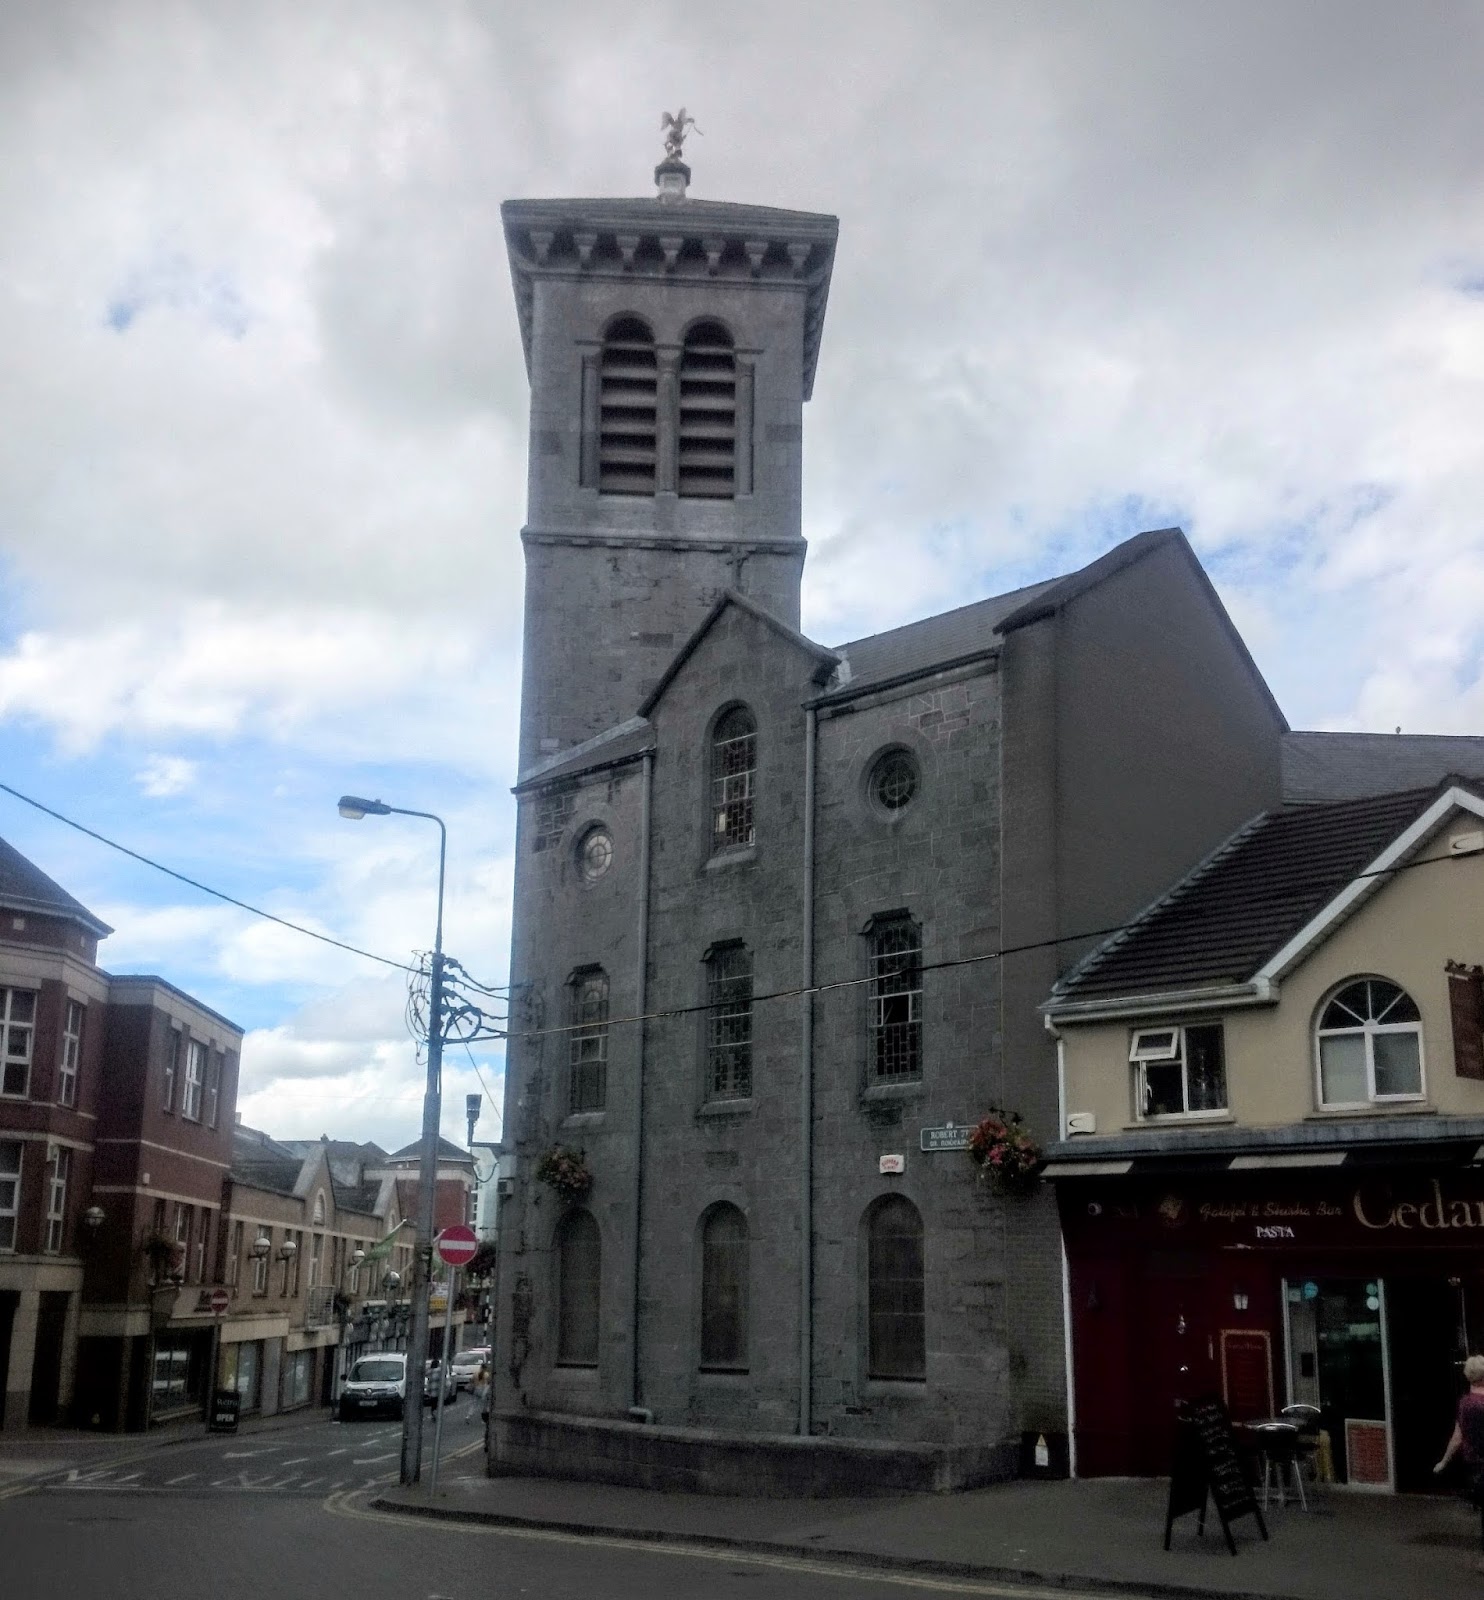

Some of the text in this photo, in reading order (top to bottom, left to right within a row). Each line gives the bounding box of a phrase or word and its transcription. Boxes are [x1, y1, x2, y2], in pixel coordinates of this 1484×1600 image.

[930, 1129, 958, 1139] ROBERT
[1256, 1225, 1296, 1238] PASTA
[216, 1413, 235, 1423] OPEN
